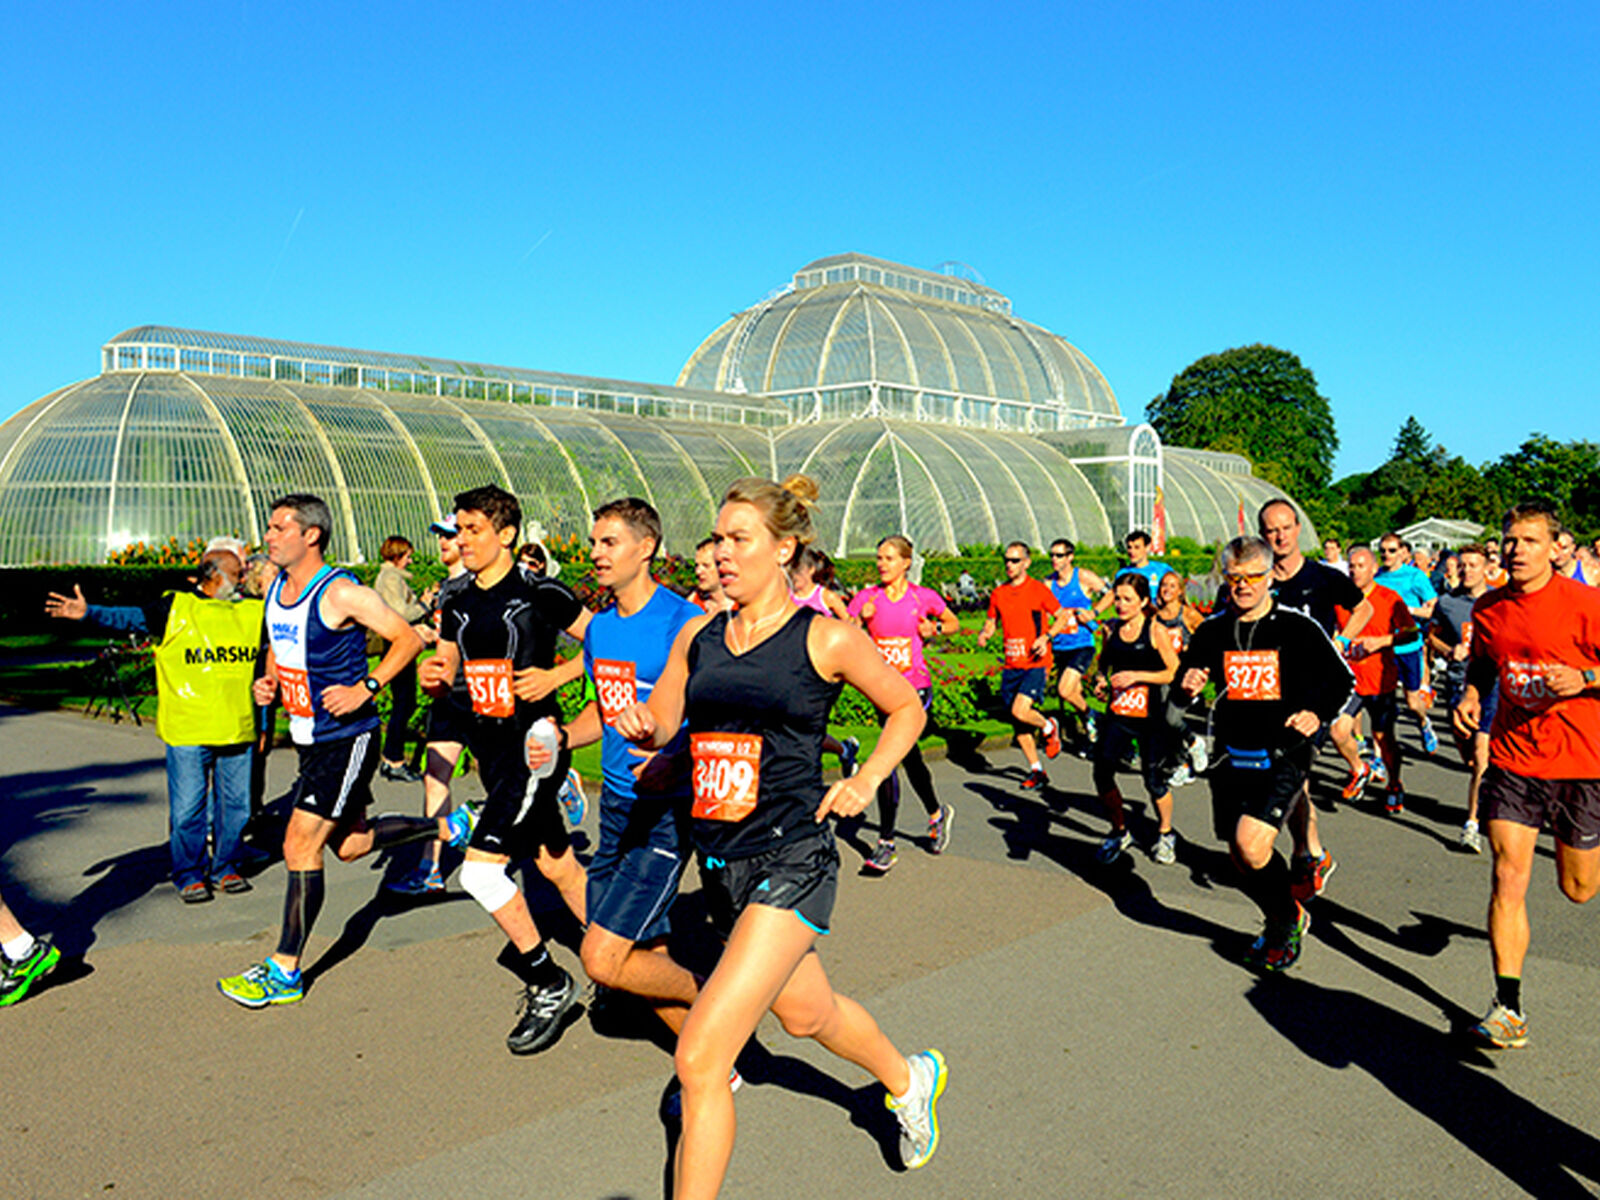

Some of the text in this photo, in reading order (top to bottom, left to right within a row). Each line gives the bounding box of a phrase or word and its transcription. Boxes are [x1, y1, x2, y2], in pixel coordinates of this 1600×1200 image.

[466, 676, 511, 704] 3514
[1228, 665, 1276, 690] 3273
[1506, 673, 1557, 699] 320
[697, 758, 755, 801] 3409
